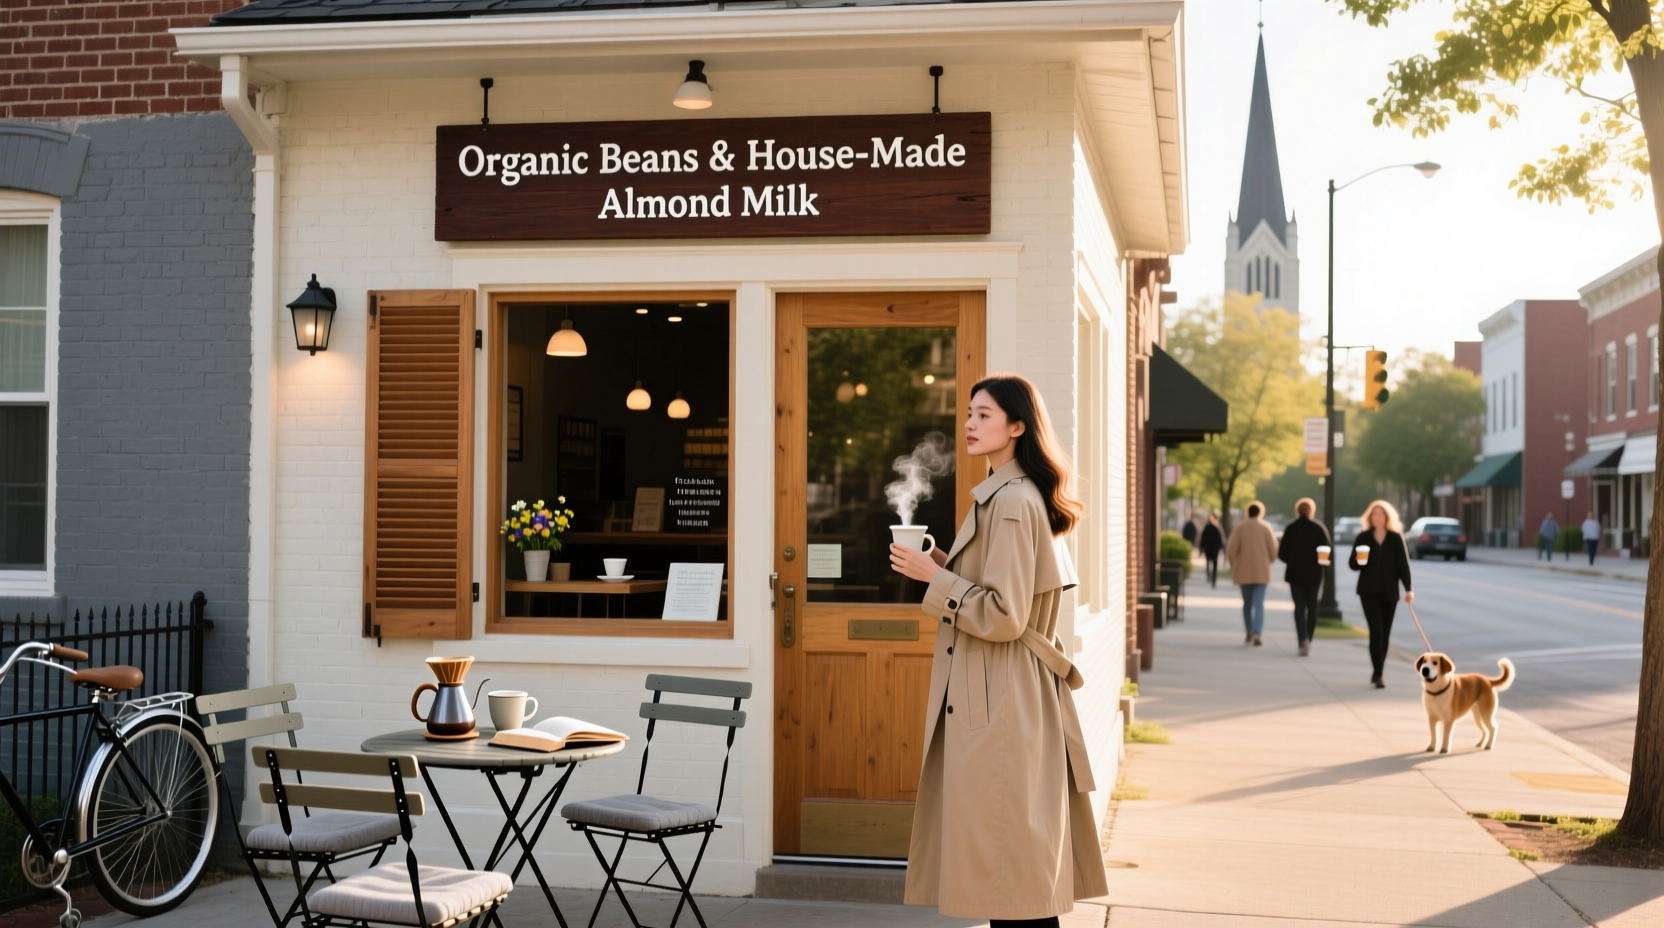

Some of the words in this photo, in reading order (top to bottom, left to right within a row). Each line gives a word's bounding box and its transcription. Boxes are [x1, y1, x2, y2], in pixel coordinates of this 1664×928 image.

[458, 143, 589, 186] Organic
[599, 143, 699, 174] Beans
[709, 139, 736, 172] &
[746, 133, 967, 171] House-Made
[597, 184, 732, 220] Almond
[740, 182, 820, 217] Milk
